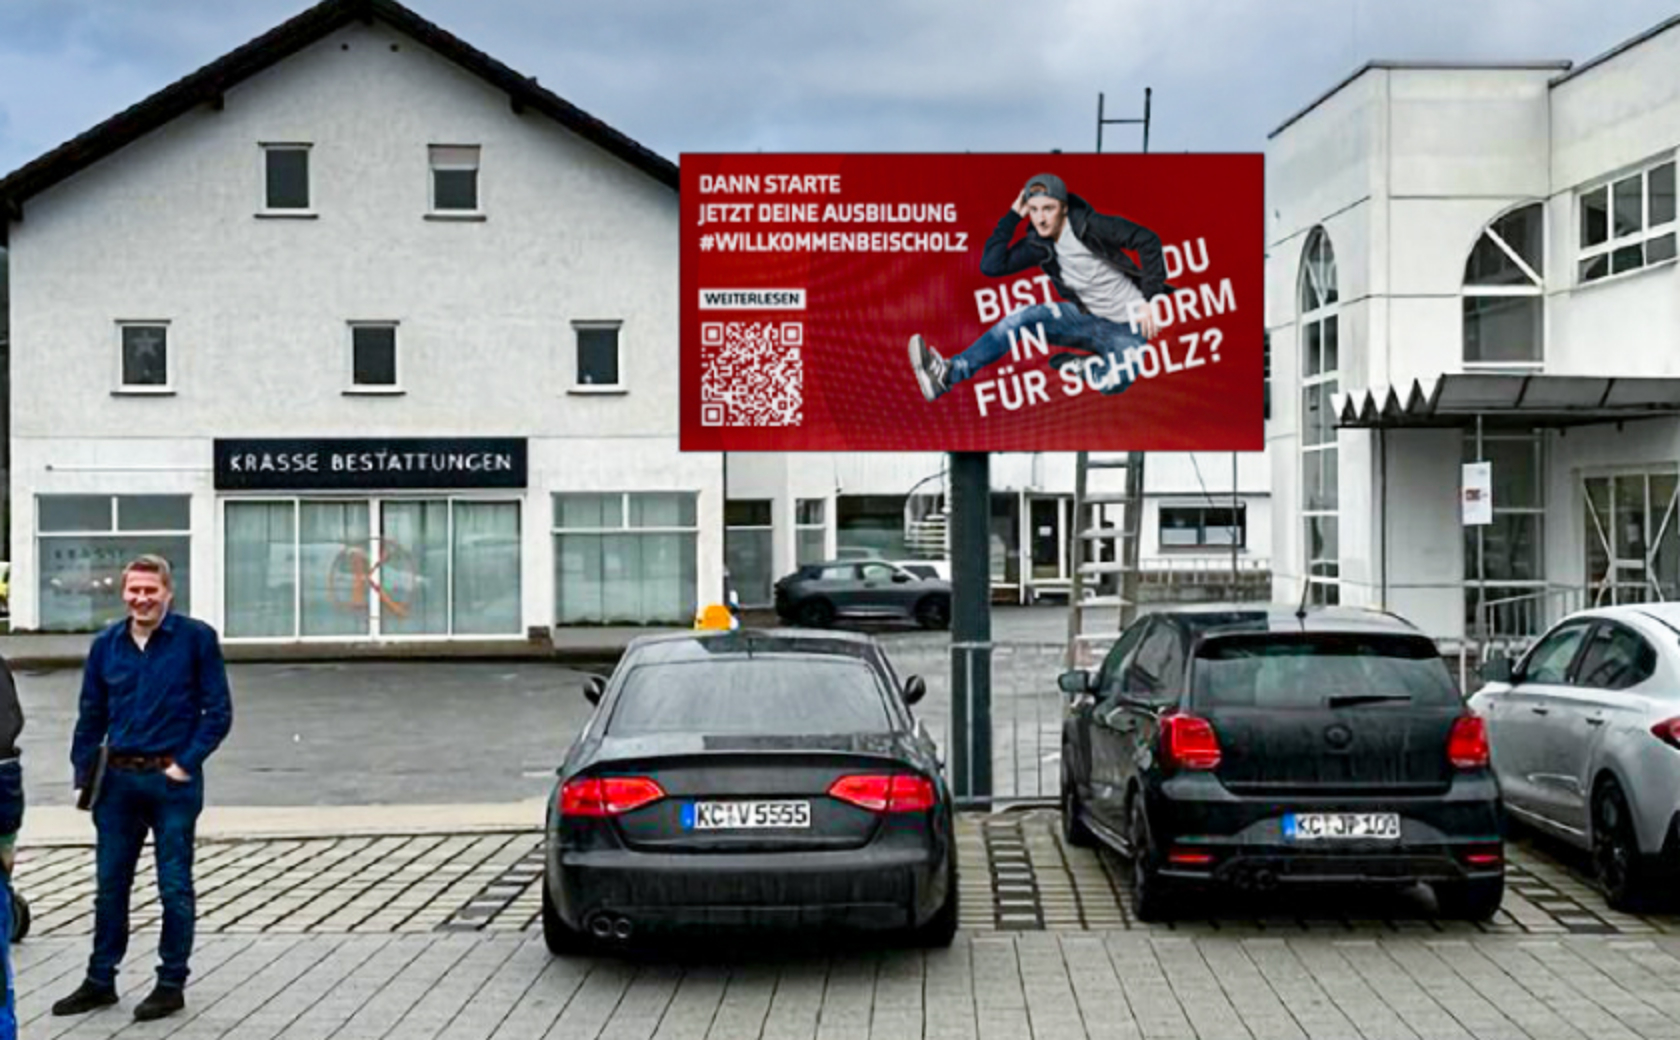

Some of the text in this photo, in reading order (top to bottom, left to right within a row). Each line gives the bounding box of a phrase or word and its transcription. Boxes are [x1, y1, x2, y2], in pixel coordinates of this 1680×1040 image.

[699, 174, 841, 194] DANN STARTE
[697, 203, 957, 225] JETZT DEINE AUSBILDUNG
[699, 232, 969, 252] #WILLKOMMENBEISCHOLZ
[1162, 237, 1210, 279] DU
[704, 292, 799, 305] WEITERLESEN
[1007, 321, 1049, 362] IN
[974, 327, 1223, 417] FÜR SCHOLZ?
[229, 452, 512, 472] KRASSE BESTATTUNGEN
